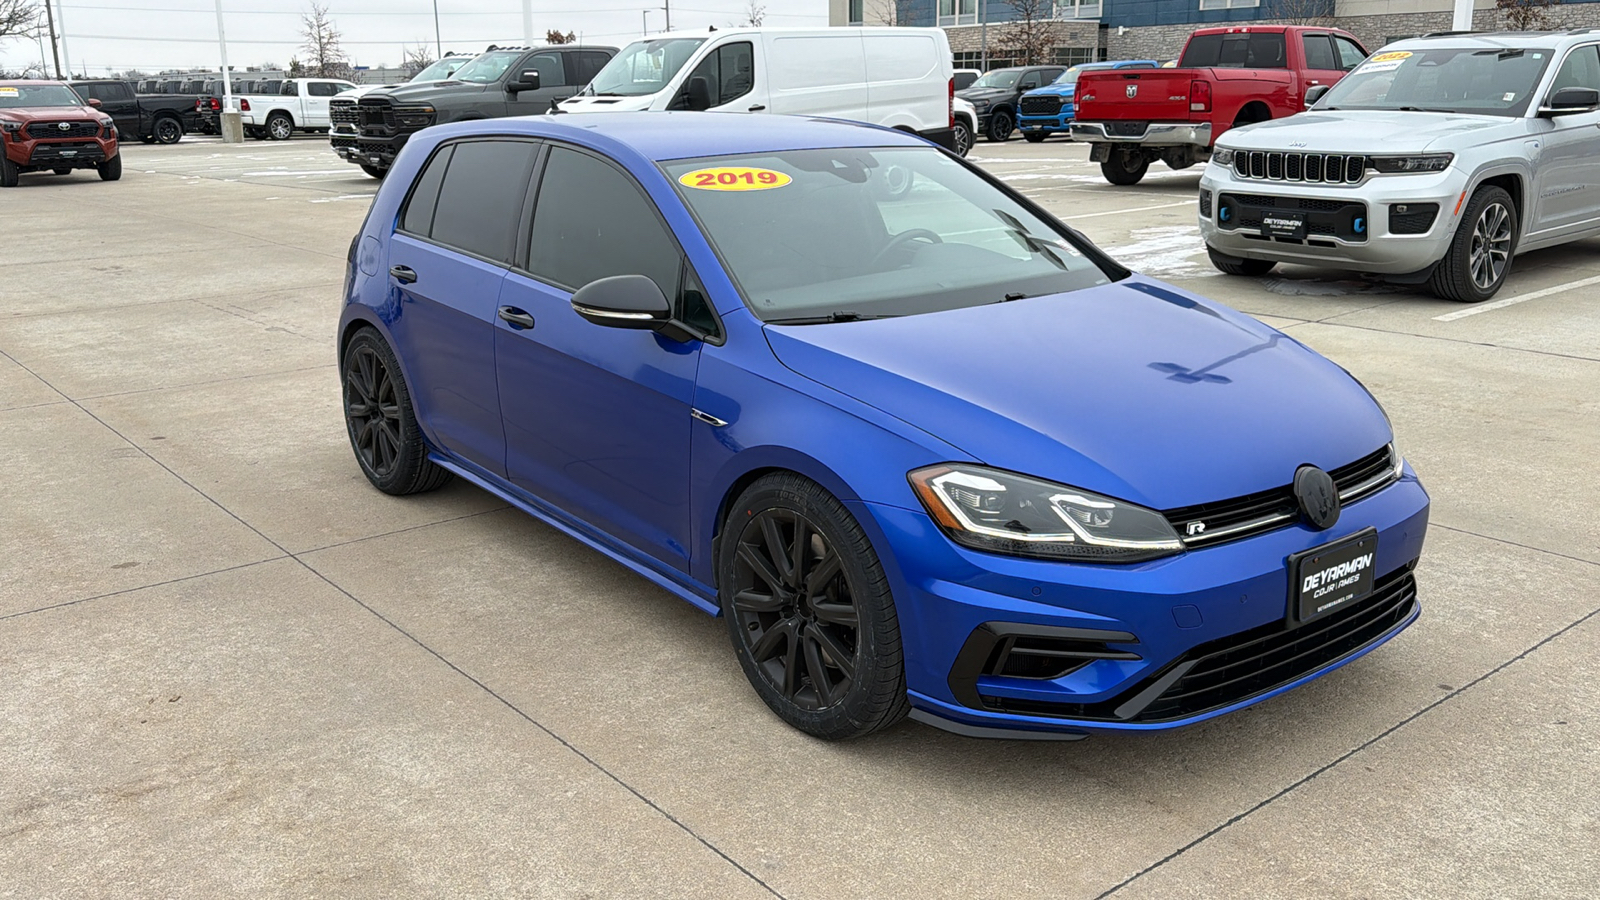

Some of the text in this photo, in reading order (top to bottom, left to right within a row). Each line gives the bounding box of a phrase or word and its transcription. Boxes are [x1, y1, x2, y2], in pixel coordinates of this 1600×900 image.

[695, 172, 778, 186] 2019
[1186, 520, 1206, 535] R
[1302, 552, 1374, 593] DEYARMAN
[1313, 573, 1361, 599] CDJR AMES
